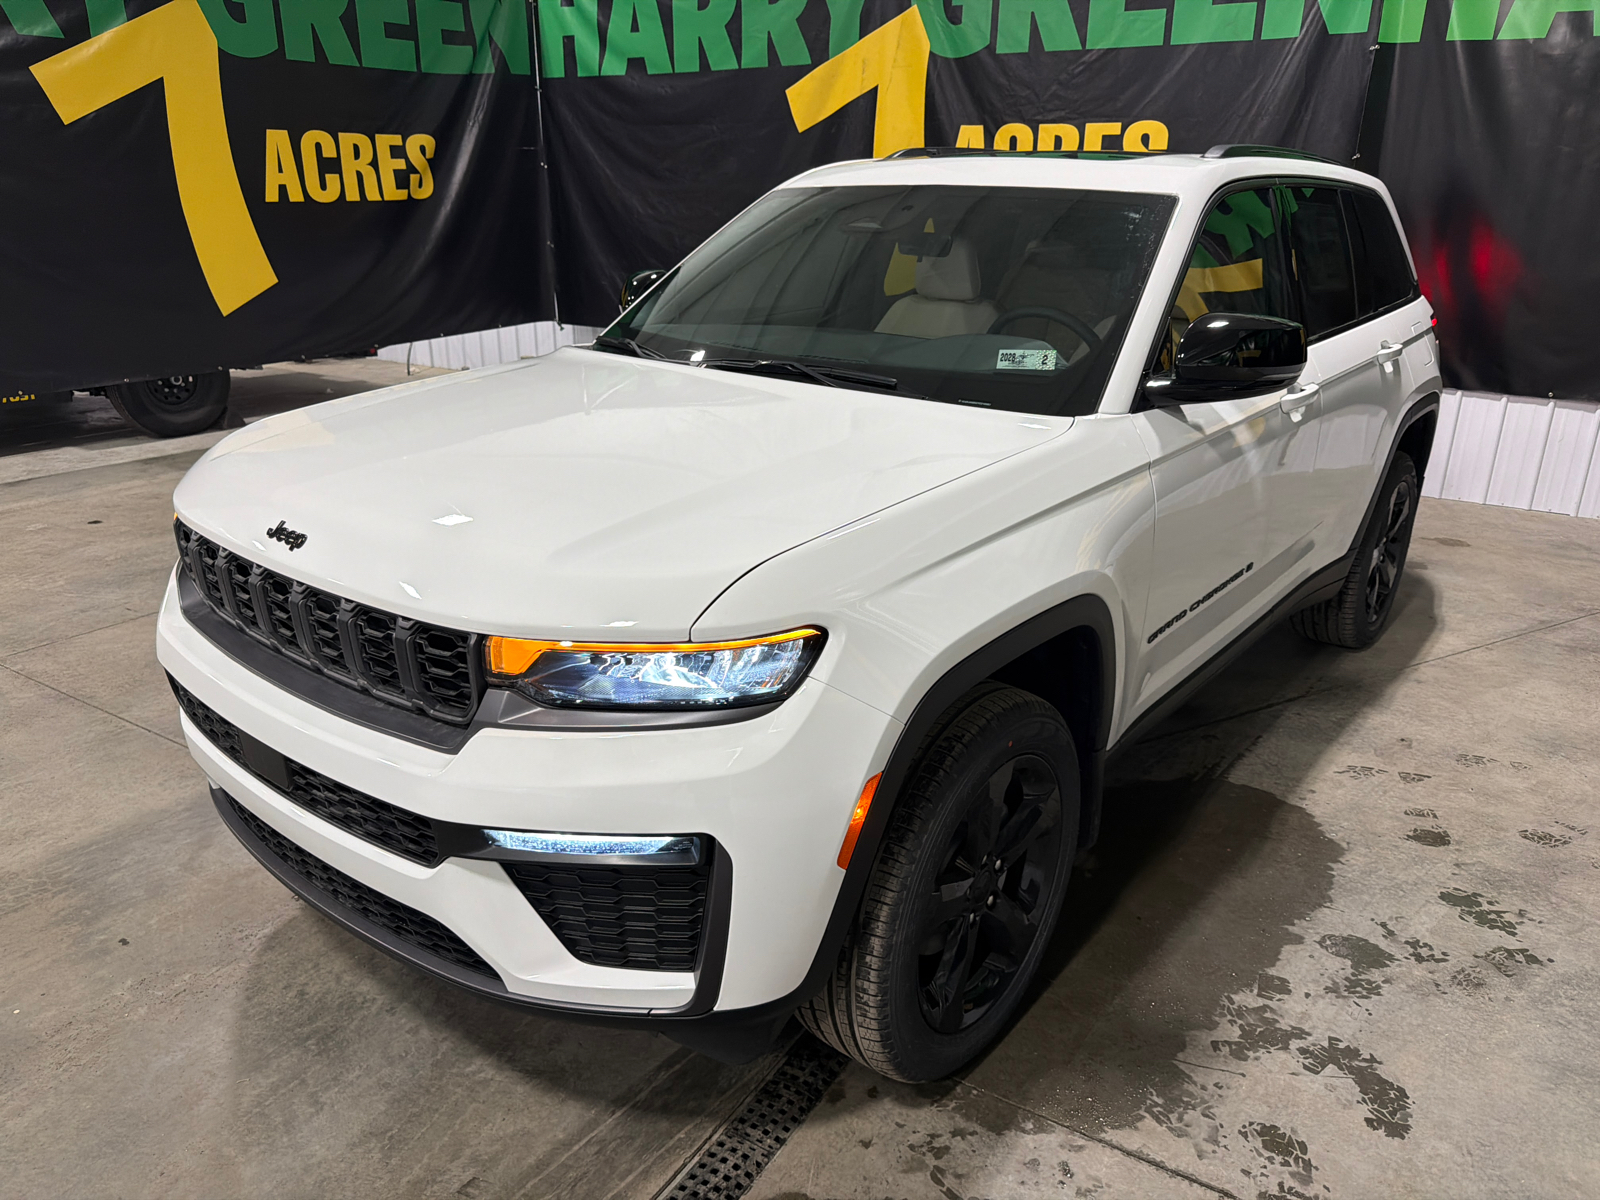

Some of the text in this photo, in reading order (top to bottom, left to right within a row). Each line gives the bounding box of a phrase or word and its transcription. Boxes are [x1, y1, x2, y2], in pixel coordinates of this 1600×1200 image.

[29, 0, 278, 317] 7
[265, 129, 436, 203] ACRES
[1041, 354, 1049, 365] 2
[266, 520, 308, 552] Jeep
